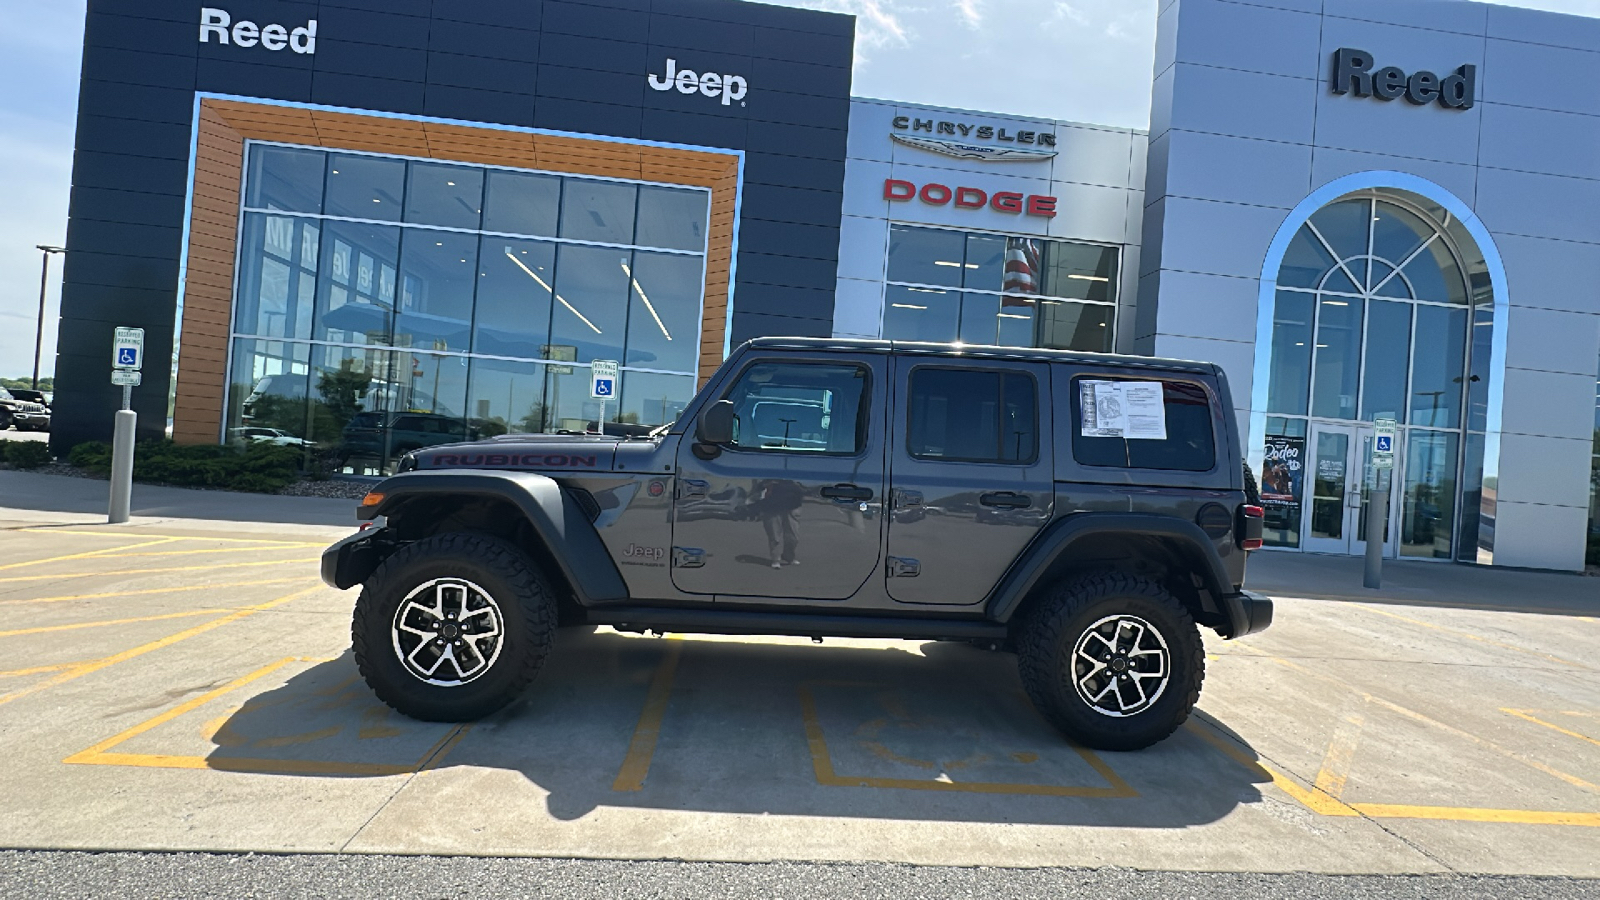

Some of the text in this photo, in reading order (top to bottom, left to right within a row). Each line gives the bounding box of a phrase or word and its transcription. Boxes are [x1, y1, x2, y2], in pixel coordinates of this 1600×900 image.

[199, 7, 318, 55] Reed
[647, 58, 748, 106] Jeep
[1332, 47, 1476, 110] Reed
[892, 115, 1057, 147] CHRYSLER
[884, 178, 1058, 218] DODGE
[433, 453, 597, 468] RUBICON
[622, 542, 664, 561] Jeep
